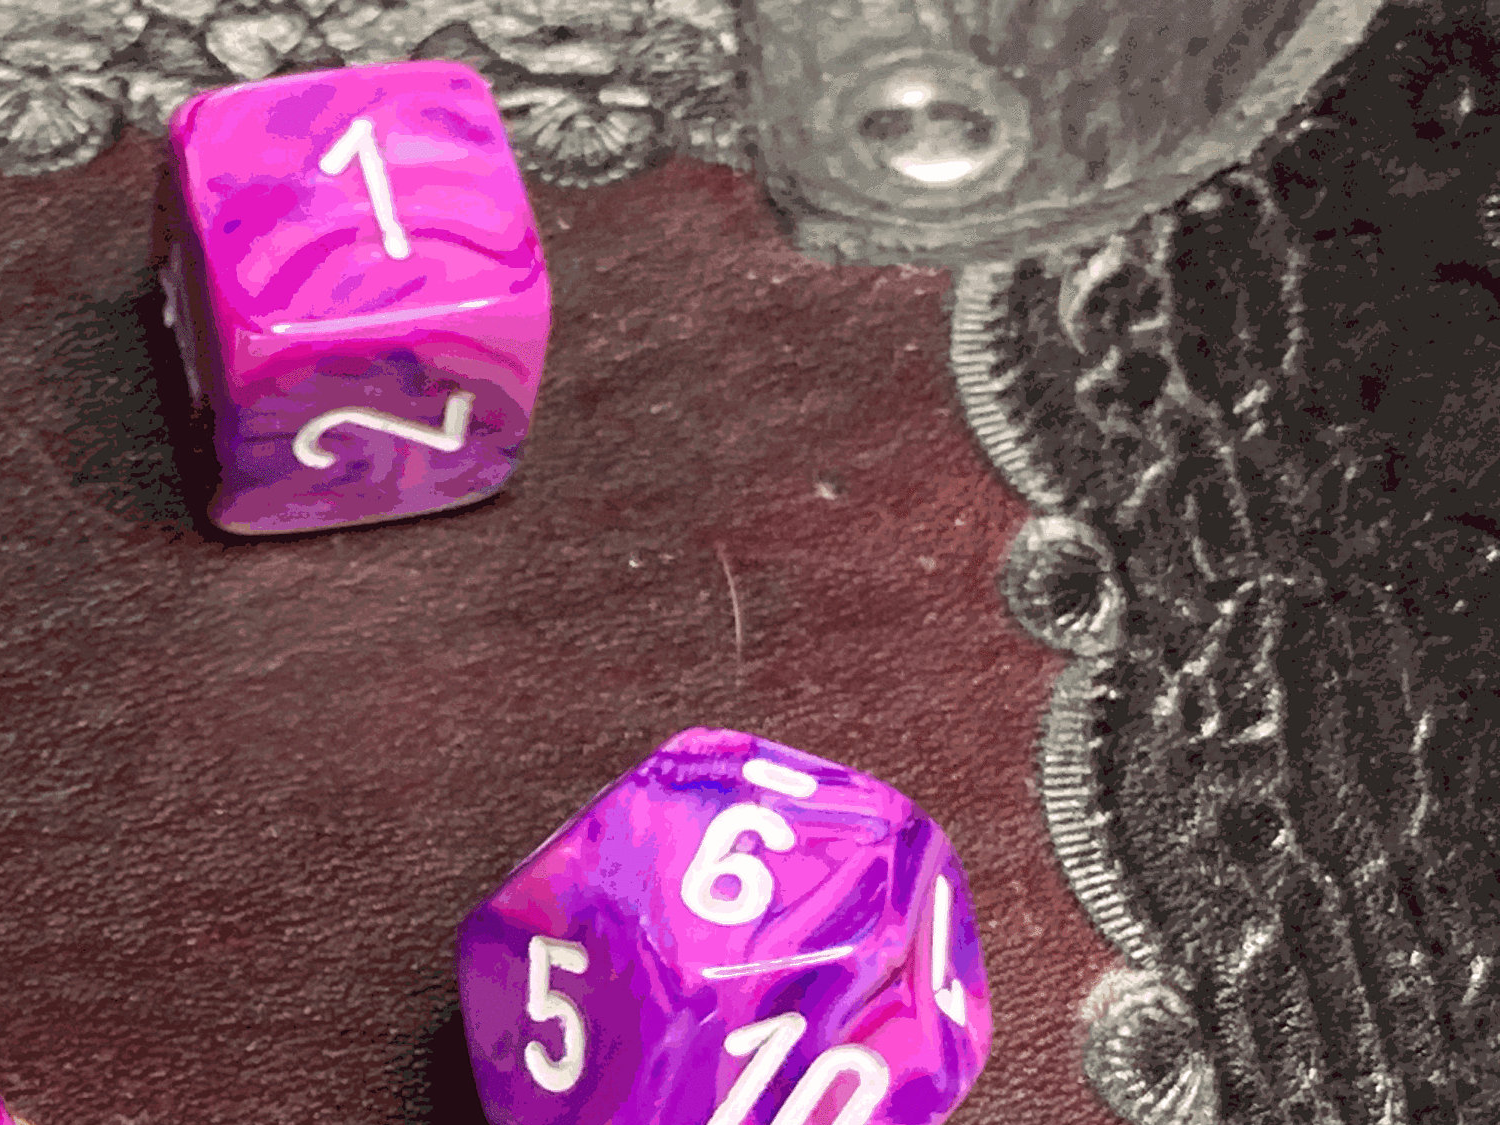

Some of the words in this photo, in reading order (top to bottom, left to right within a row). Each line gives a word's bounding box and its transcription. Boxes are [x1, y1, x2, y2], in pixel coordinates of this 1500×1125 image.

[318, 117, 410, 260] 1
[291, 391, 474, 470] 2
[523, 935, 588, 1093] 5
